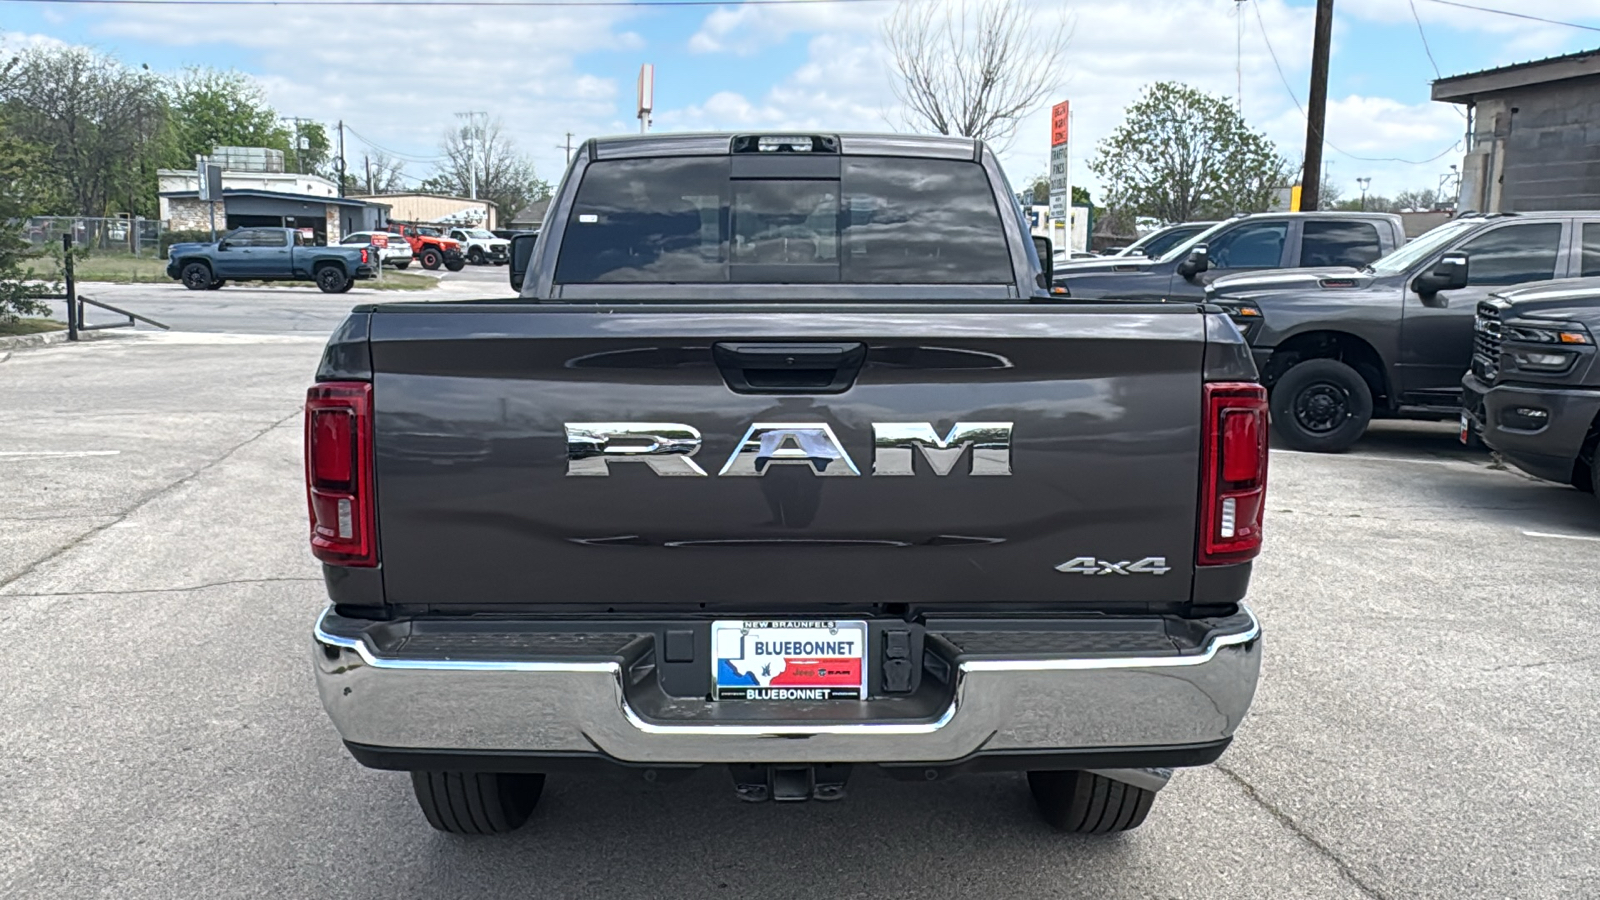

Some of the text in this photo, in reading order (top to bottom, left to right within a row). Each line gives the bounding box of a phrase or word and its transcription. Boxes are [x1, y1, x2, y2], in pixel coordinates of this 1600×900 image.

[564, 422, 1014, 477] RAM
[1055, 556, 1172, 575] 4x4
[744, 620, 836, 629] NEW BRAUNFELS
[754, 641, 855, 656] BLUEBONNET
[746, 689, 831, 700] BLUEBONNET
